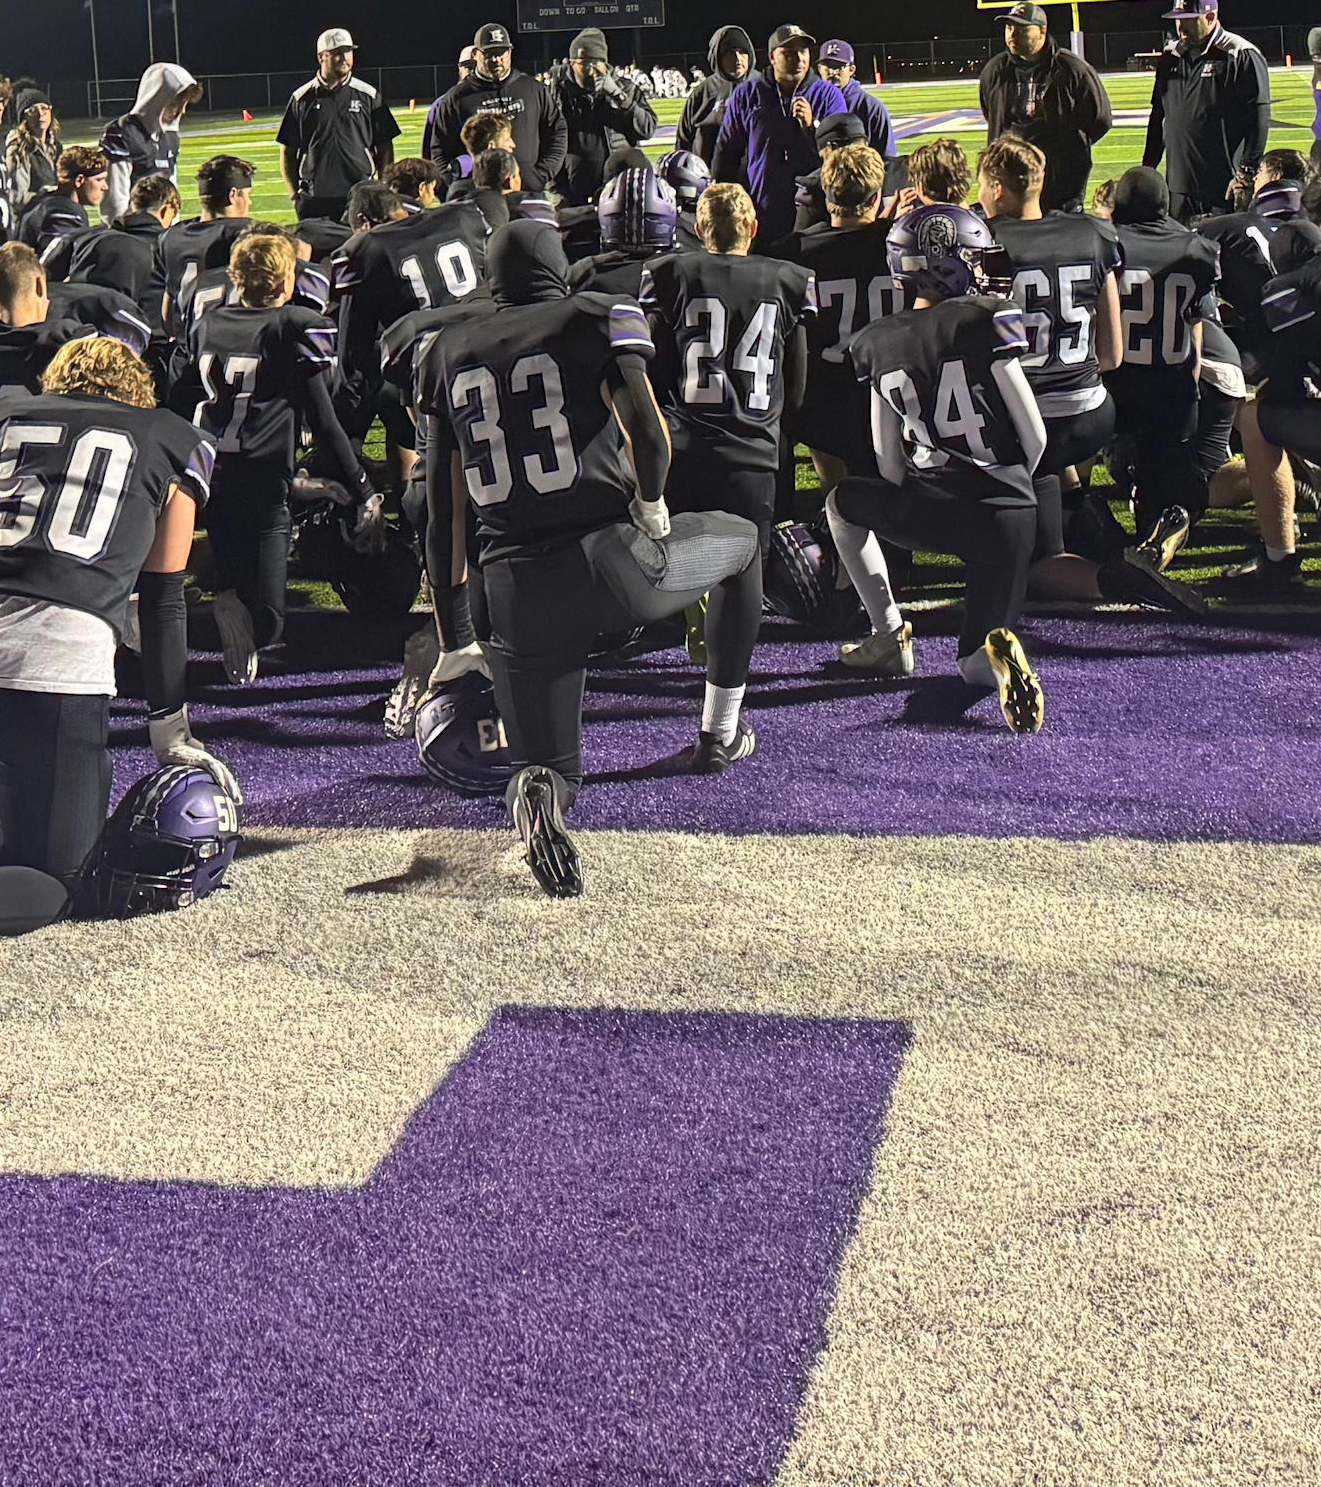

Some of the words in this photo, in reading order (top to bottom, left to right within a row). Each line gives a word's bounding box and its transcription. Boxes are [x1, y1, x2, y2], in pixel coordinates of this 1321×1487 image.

[400, 241, 478, 311] 10
[1011, 264, 1093, 367] 65
[1119, 269, 1197, 365] 20
[684, 297, 778, 411] 24
[451, 353, 578, 507] 33
[879, 359, 998, 470] 84
[213, 795, 238, 833] 50
